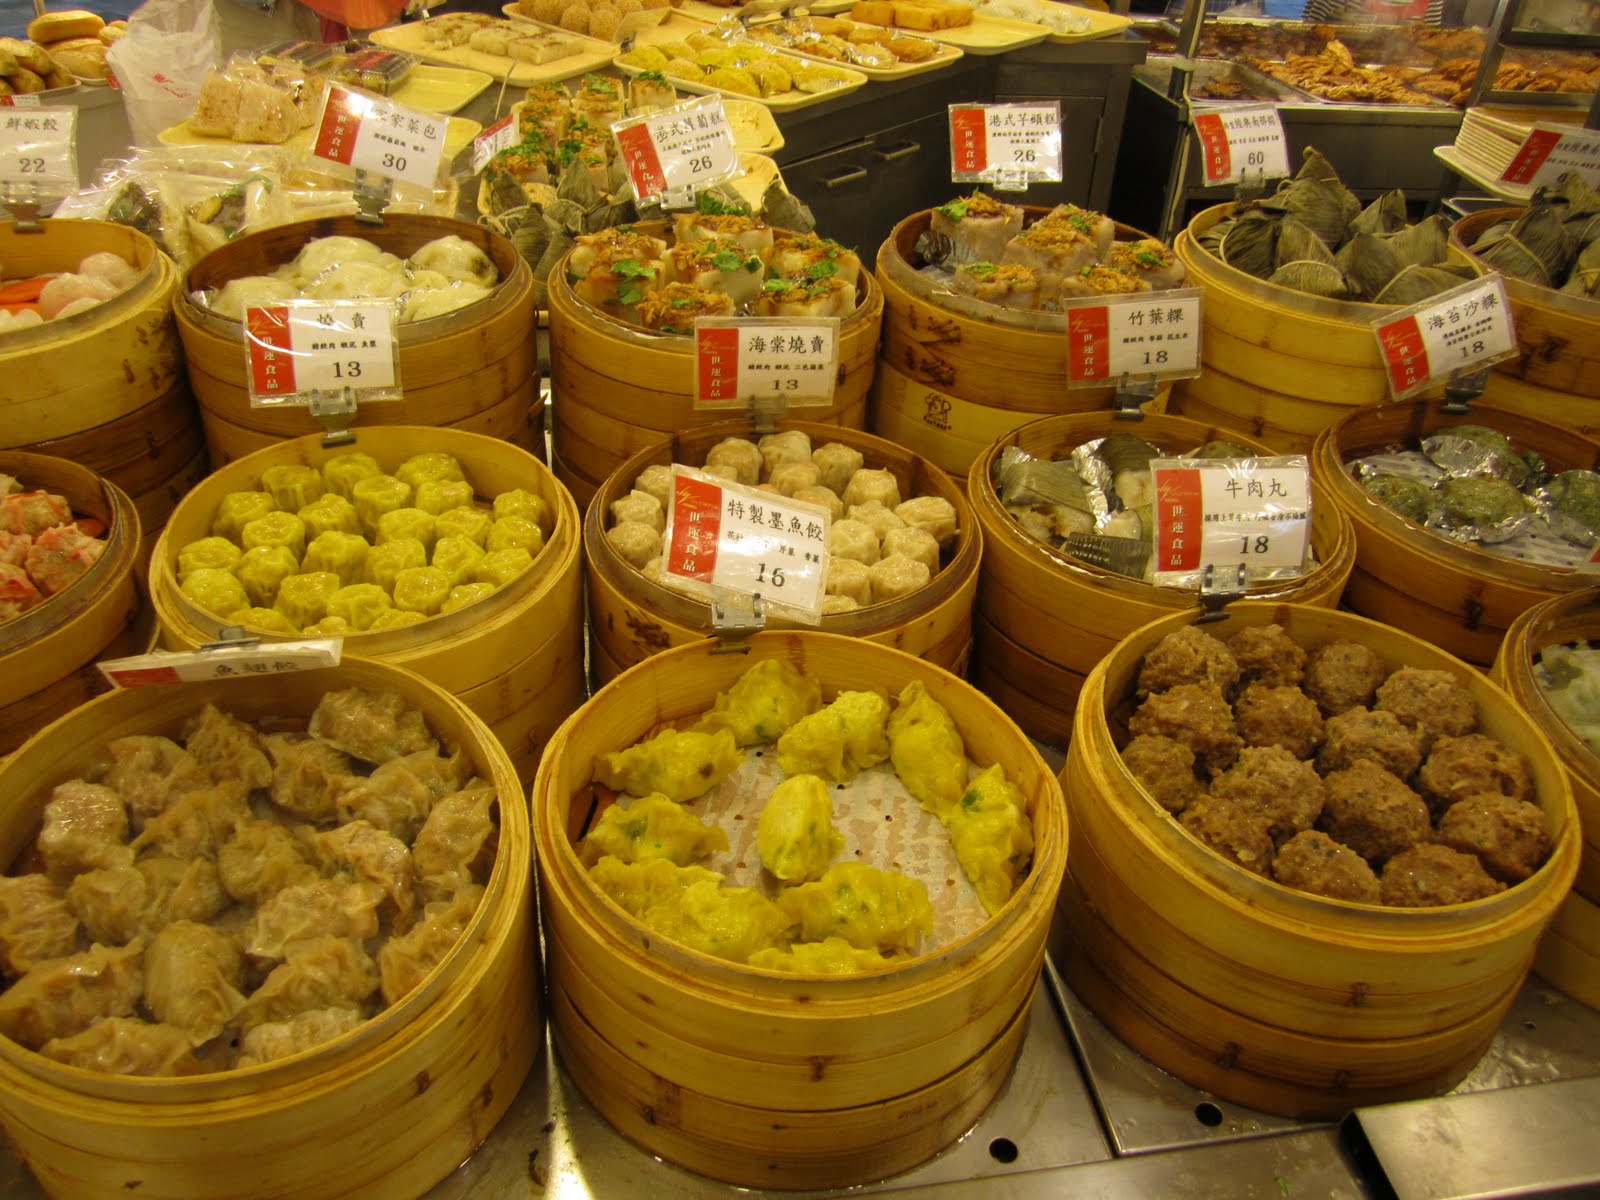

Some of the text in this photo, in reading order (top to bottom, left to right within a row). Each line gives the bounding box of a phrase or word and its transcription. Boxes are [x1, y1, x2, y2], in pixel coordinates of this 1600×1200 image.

[5, 117, 58, 131] 鮮蝦餃
[989, 112, 1057, 127] 港式芋頭糕
[965, 129, 975, 169] 世運食品
[1014, 149, 1036, 163] 26
[1248, 151, 1264, 165] 60
[19, 157, 46, 173] 22
[382, 153, 407, 171] 30
[689, 155, 713, 173] 26
[1128, 308, 1185, 326] 竹葉粿
[1428, 293, 1498, 331] 海苔沙粿
[749, 335, 825, 354] 海棠燒賣
[1460, 341, 1485, 359] 18
[1083, 333, 1095, 376] 世運食品
[1143, 350, 1169, 365] 18
[332, 361, 362, 378] 13
[711, 356, 721, 397] 世運食品
[772, 379, 799, 391] 13
[1224, 477, 1288, 499] 牛肉丸
[727, 499, 825, 542] 特製墨魚餃
[683, 511, 701, 573] 世運食品
[1170, 504, 1185, 566] 世運食品
[1239, 535, 1270, 555] 18
[755, 562, 786, 588] 16
